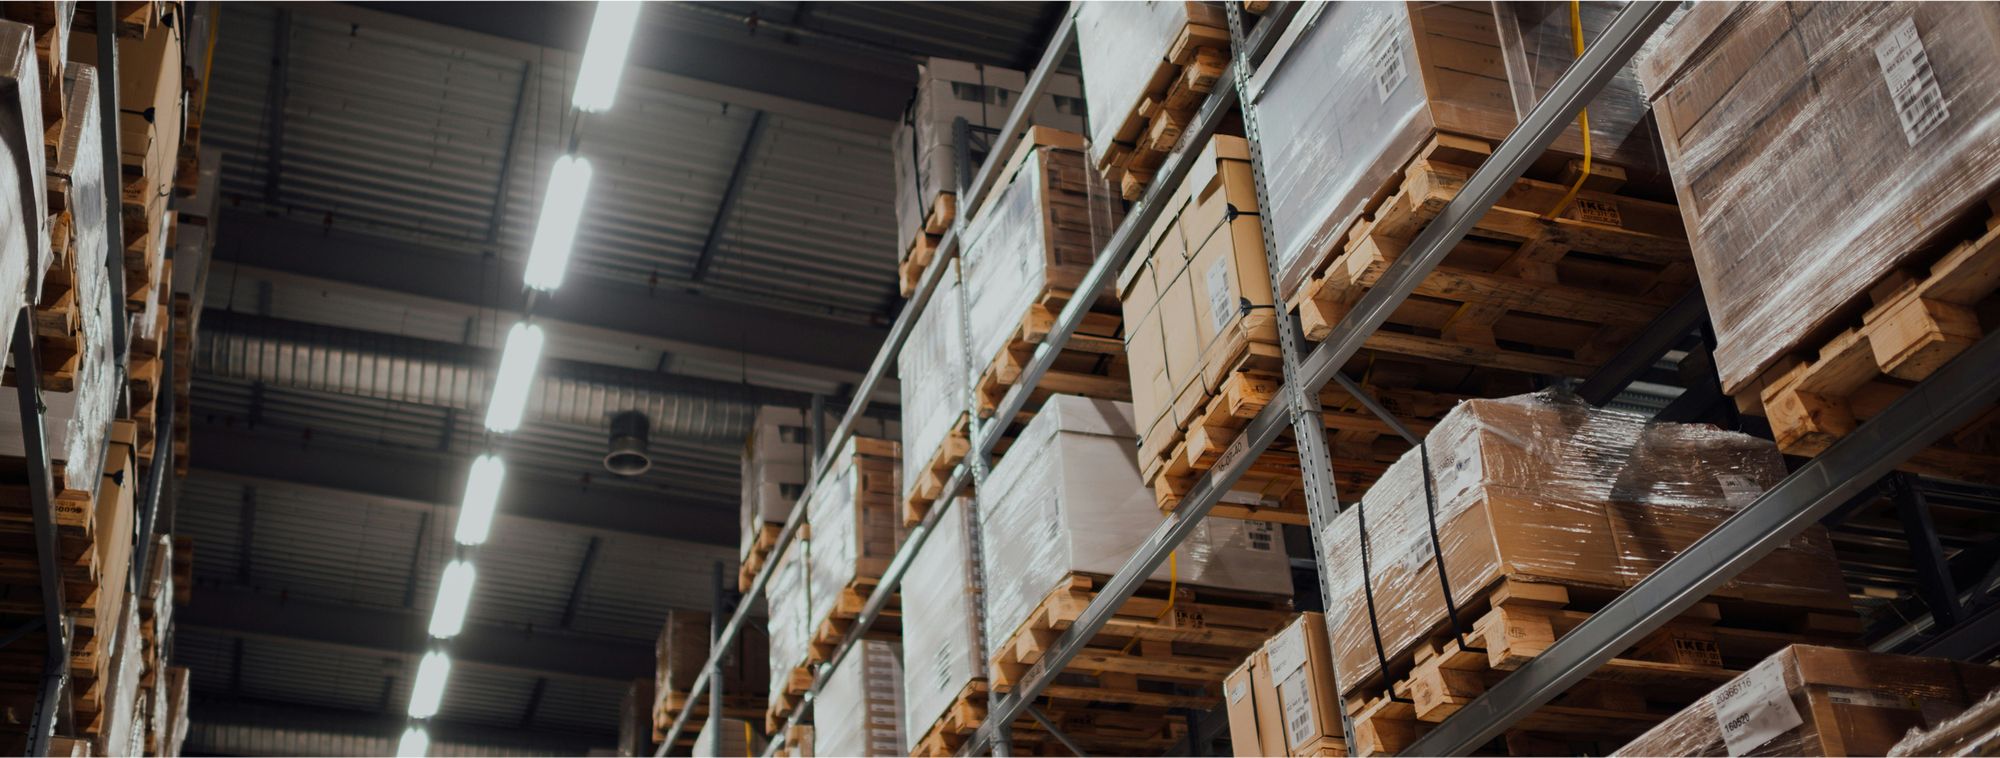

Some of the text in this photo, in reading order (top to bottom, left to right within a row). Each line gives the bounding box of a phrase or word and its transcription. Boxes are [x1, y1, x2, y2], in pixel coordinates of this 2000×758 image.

[1580, 200, 1617, 212] IKEA
[1676, 640, 1717, 652] IKEA
[1716, 677, 1752, 705] 20366116
[1724, 712, 1750, 733] 160520
